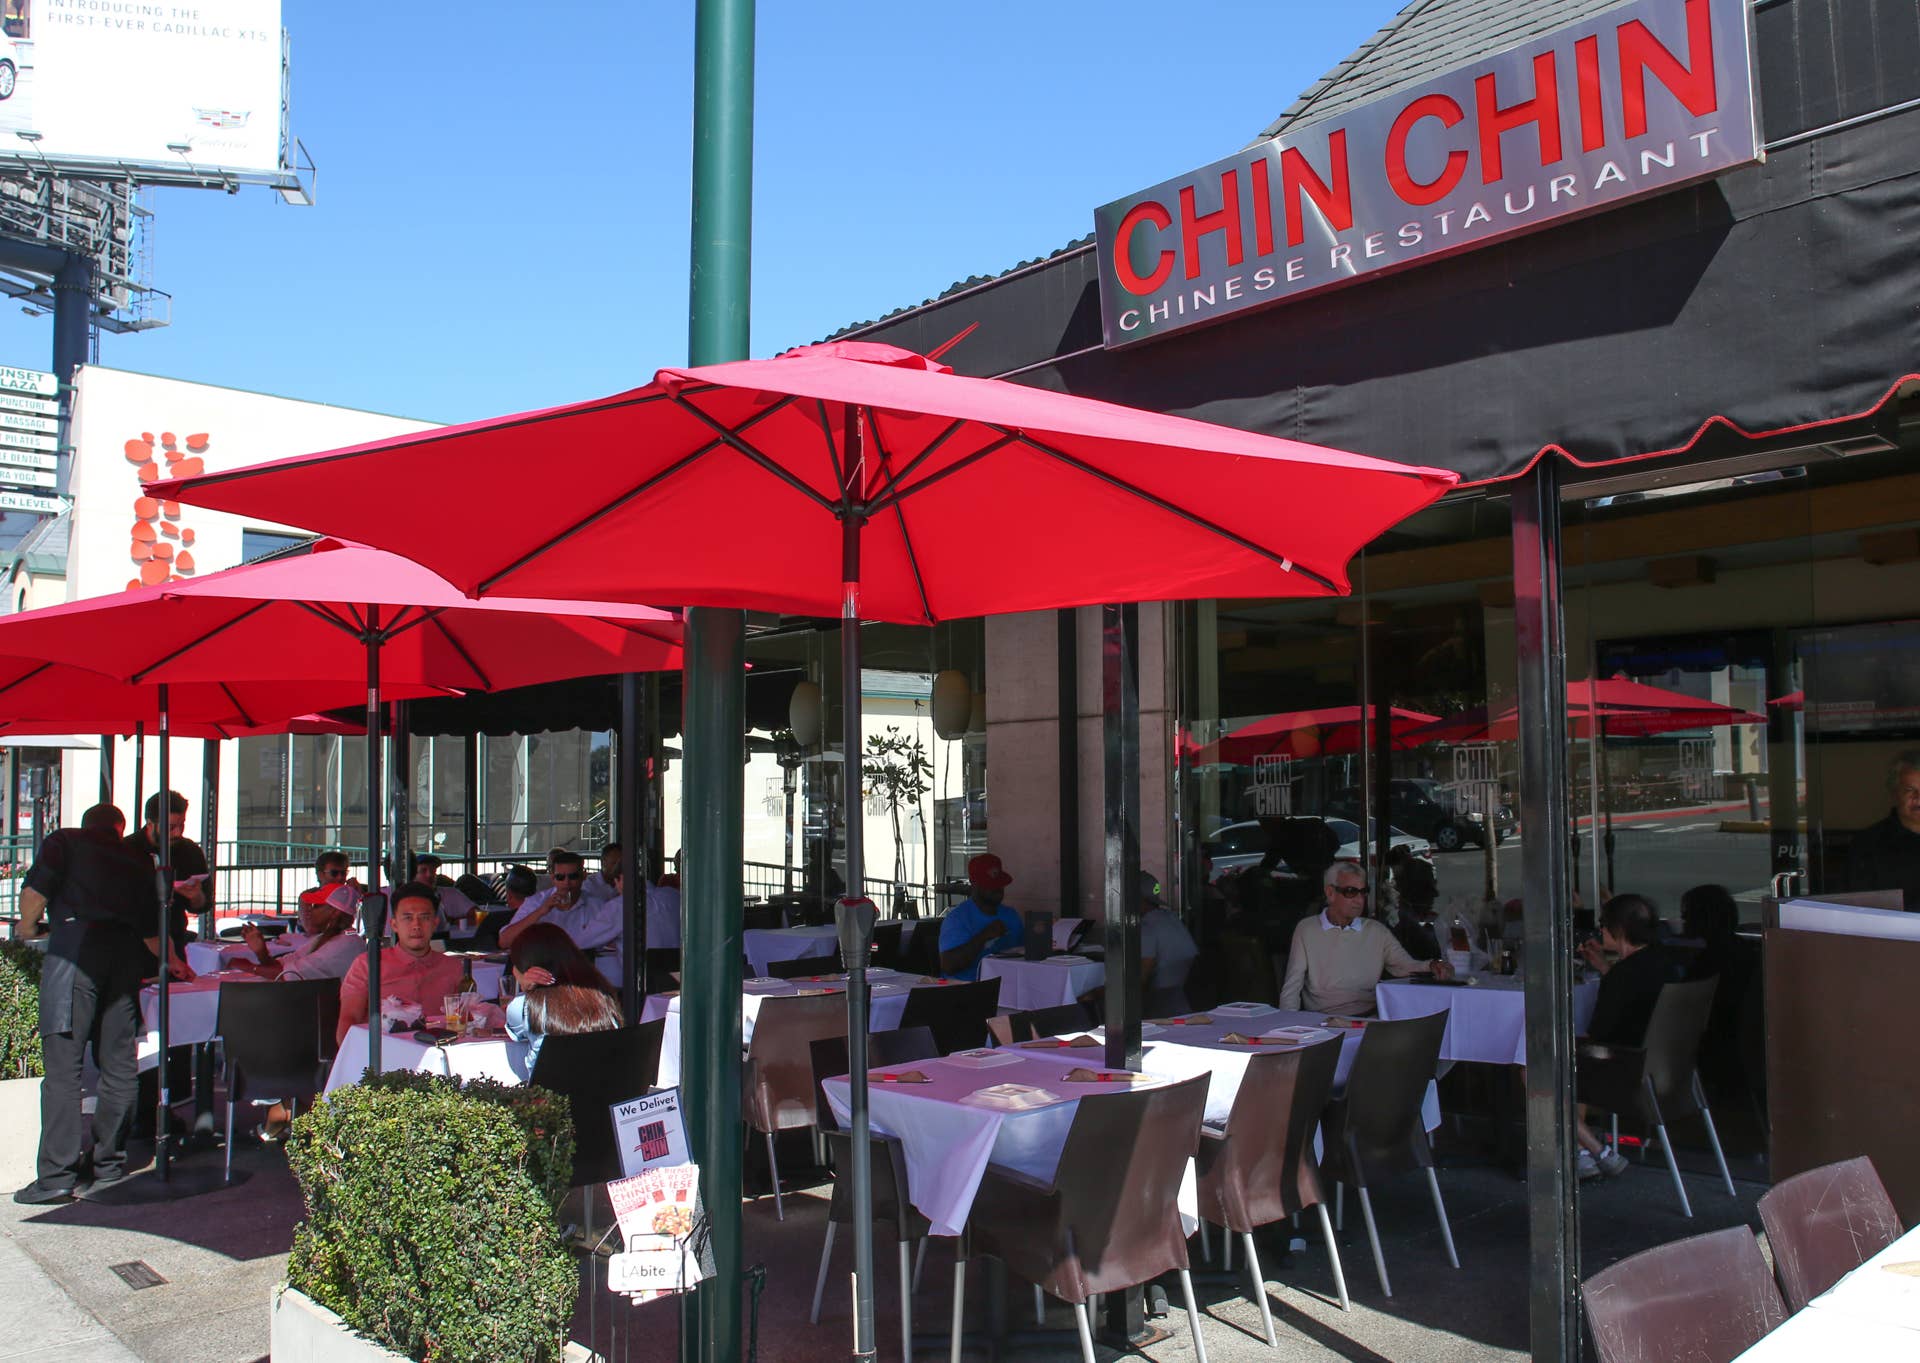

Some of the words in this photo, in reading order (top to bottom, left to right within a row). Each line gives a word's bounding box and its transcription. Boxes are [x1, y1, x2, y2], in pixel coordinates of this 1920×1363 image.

[48, 0, 163, 17] INTRODUCING
[172, 8, 200, 20] THE
[48, 12, 145, 31] FIRST-EVER
[153, 22, 231, 38] CADILLAC
[239, 30, 268, 42] XTS
[1113, 127, 1353, 296] CHIN
[1384, 0, 1718, 206] CHIN
[1119, 257, 1303, 331] CHINESE
[1330, 128, 1720, 269] RESTAURANT
[5, 416, 46, 429] MASSAGE
[5, 434, 40, 446] PILATES
[11, 454, 42, 465] DENTAL
[14, 473, 37, 482] YOGA
[20, 498, 53, 509] LEVEL
[1255, 754, 1291, 785] CHIN
[1455, 747, 1499, 781] CHIN
[1256, 786, 1291, 815] CHIN
[620, 1105, 637, 1116] We
[639, 1096, 675, 1112] Deliver
[638, 1121, 665, 1143] CHIN
[642, 1138, 669, 1161] CHIN
[613, 1180, 666, 1203] CHINESE
[622, 1265, 666, 1278] LAbite
